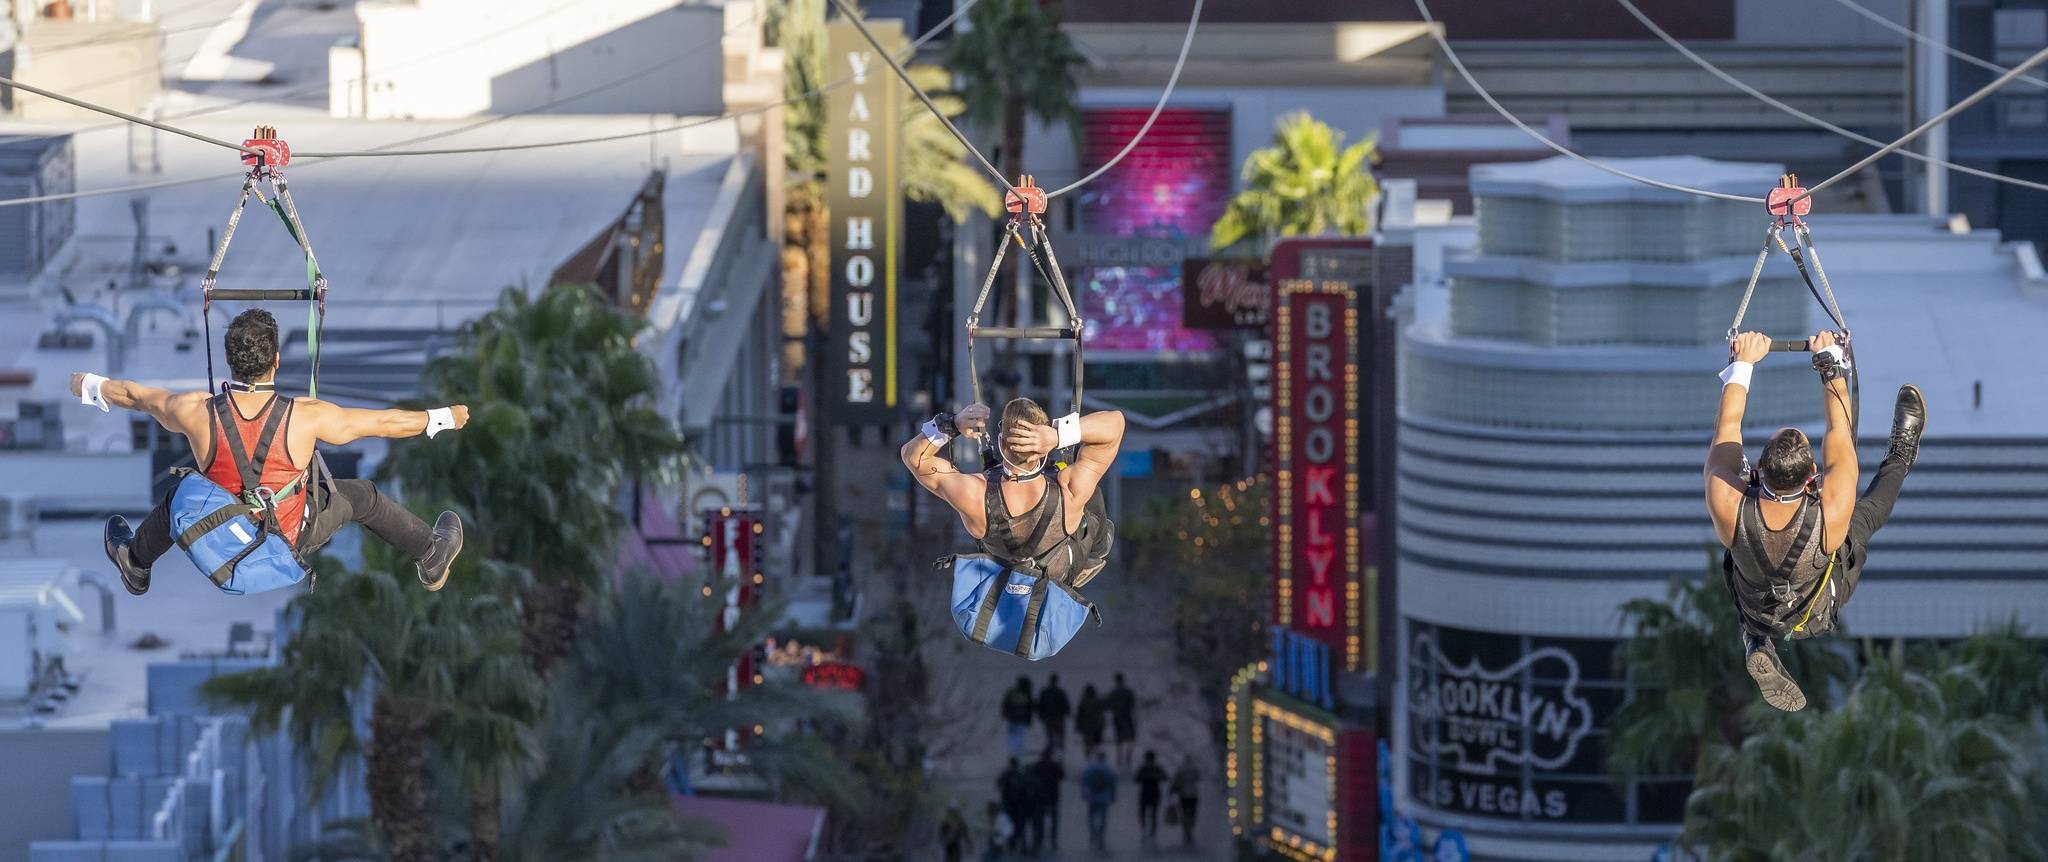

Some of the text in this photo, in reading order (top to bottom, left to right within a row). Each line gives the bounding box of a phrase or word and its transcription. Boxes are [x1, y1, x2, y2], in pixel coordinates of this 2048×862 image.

[846, 51, 874, 403] YARD HOUSE
[1304, 303, 1335, 627] BROOKLYN
[1458, 781, 1568, 818] VEGAS
